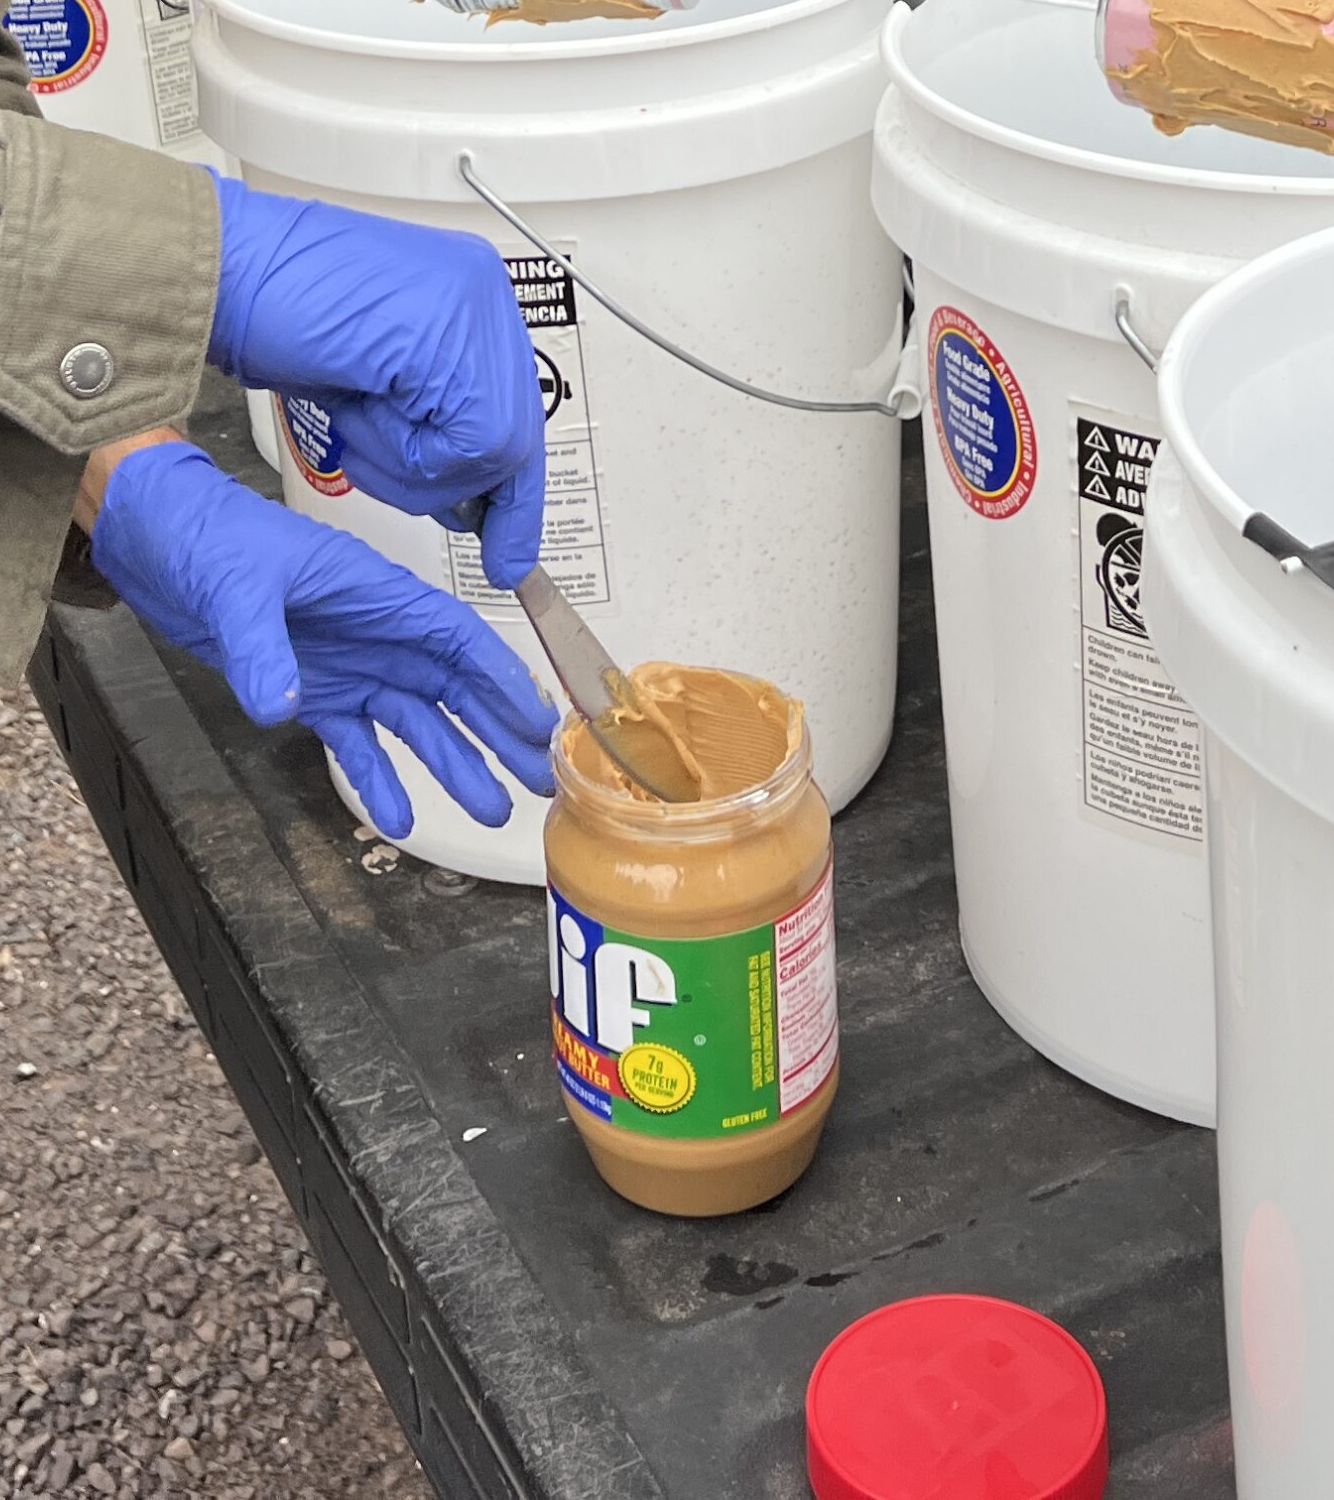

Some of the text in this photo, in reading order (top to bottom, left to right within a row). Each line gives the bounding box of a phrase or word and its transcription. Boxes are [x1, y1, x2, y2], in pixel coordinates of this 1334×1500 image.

[514, 282, 567, 303] EMENT
[942, 340, 962, 366] Food
[962, 355, 991, 382] Grade
[946, 386, 971, 418] Heavy
[971, 404, 995, 431] Duty
[995, 361, 1035, 469] Agricultural
[954, 434, 994, 472] BPA Free
[983, 480, 1030, 515] Industrial
[1087, 645, 1117, 662] drown.
[1088, 634, 1126, 655] Children
[1127, 649, 1144, 661] can
[1088, 657, 1177, 695] Keep children away
[1089, 689, 1180, 726] Les enfants peuvent
[1156, 734, 1179, 748] hors
[1181, 740, 1194, 751] de
[1143, 751, 1178, 766] volume
[1090, 772, 1133, 795] Mantenga
[1142, 791, 1157, 803] los
[1100, 787, 1130, 804] cubeta
[1132, 799, 1166, 815] aunque
[1149, 814, 1190, 830] cantidad
[568, 1050, 611, 1090] BUTTER
[648, 1053, 664, 1076] 7g
[632, 1067, 678, 1091] PROTEIN
[647, 1086, 675, 1098] SERVING
[721, 1107, 768, 1129] GLUTEN FREE
